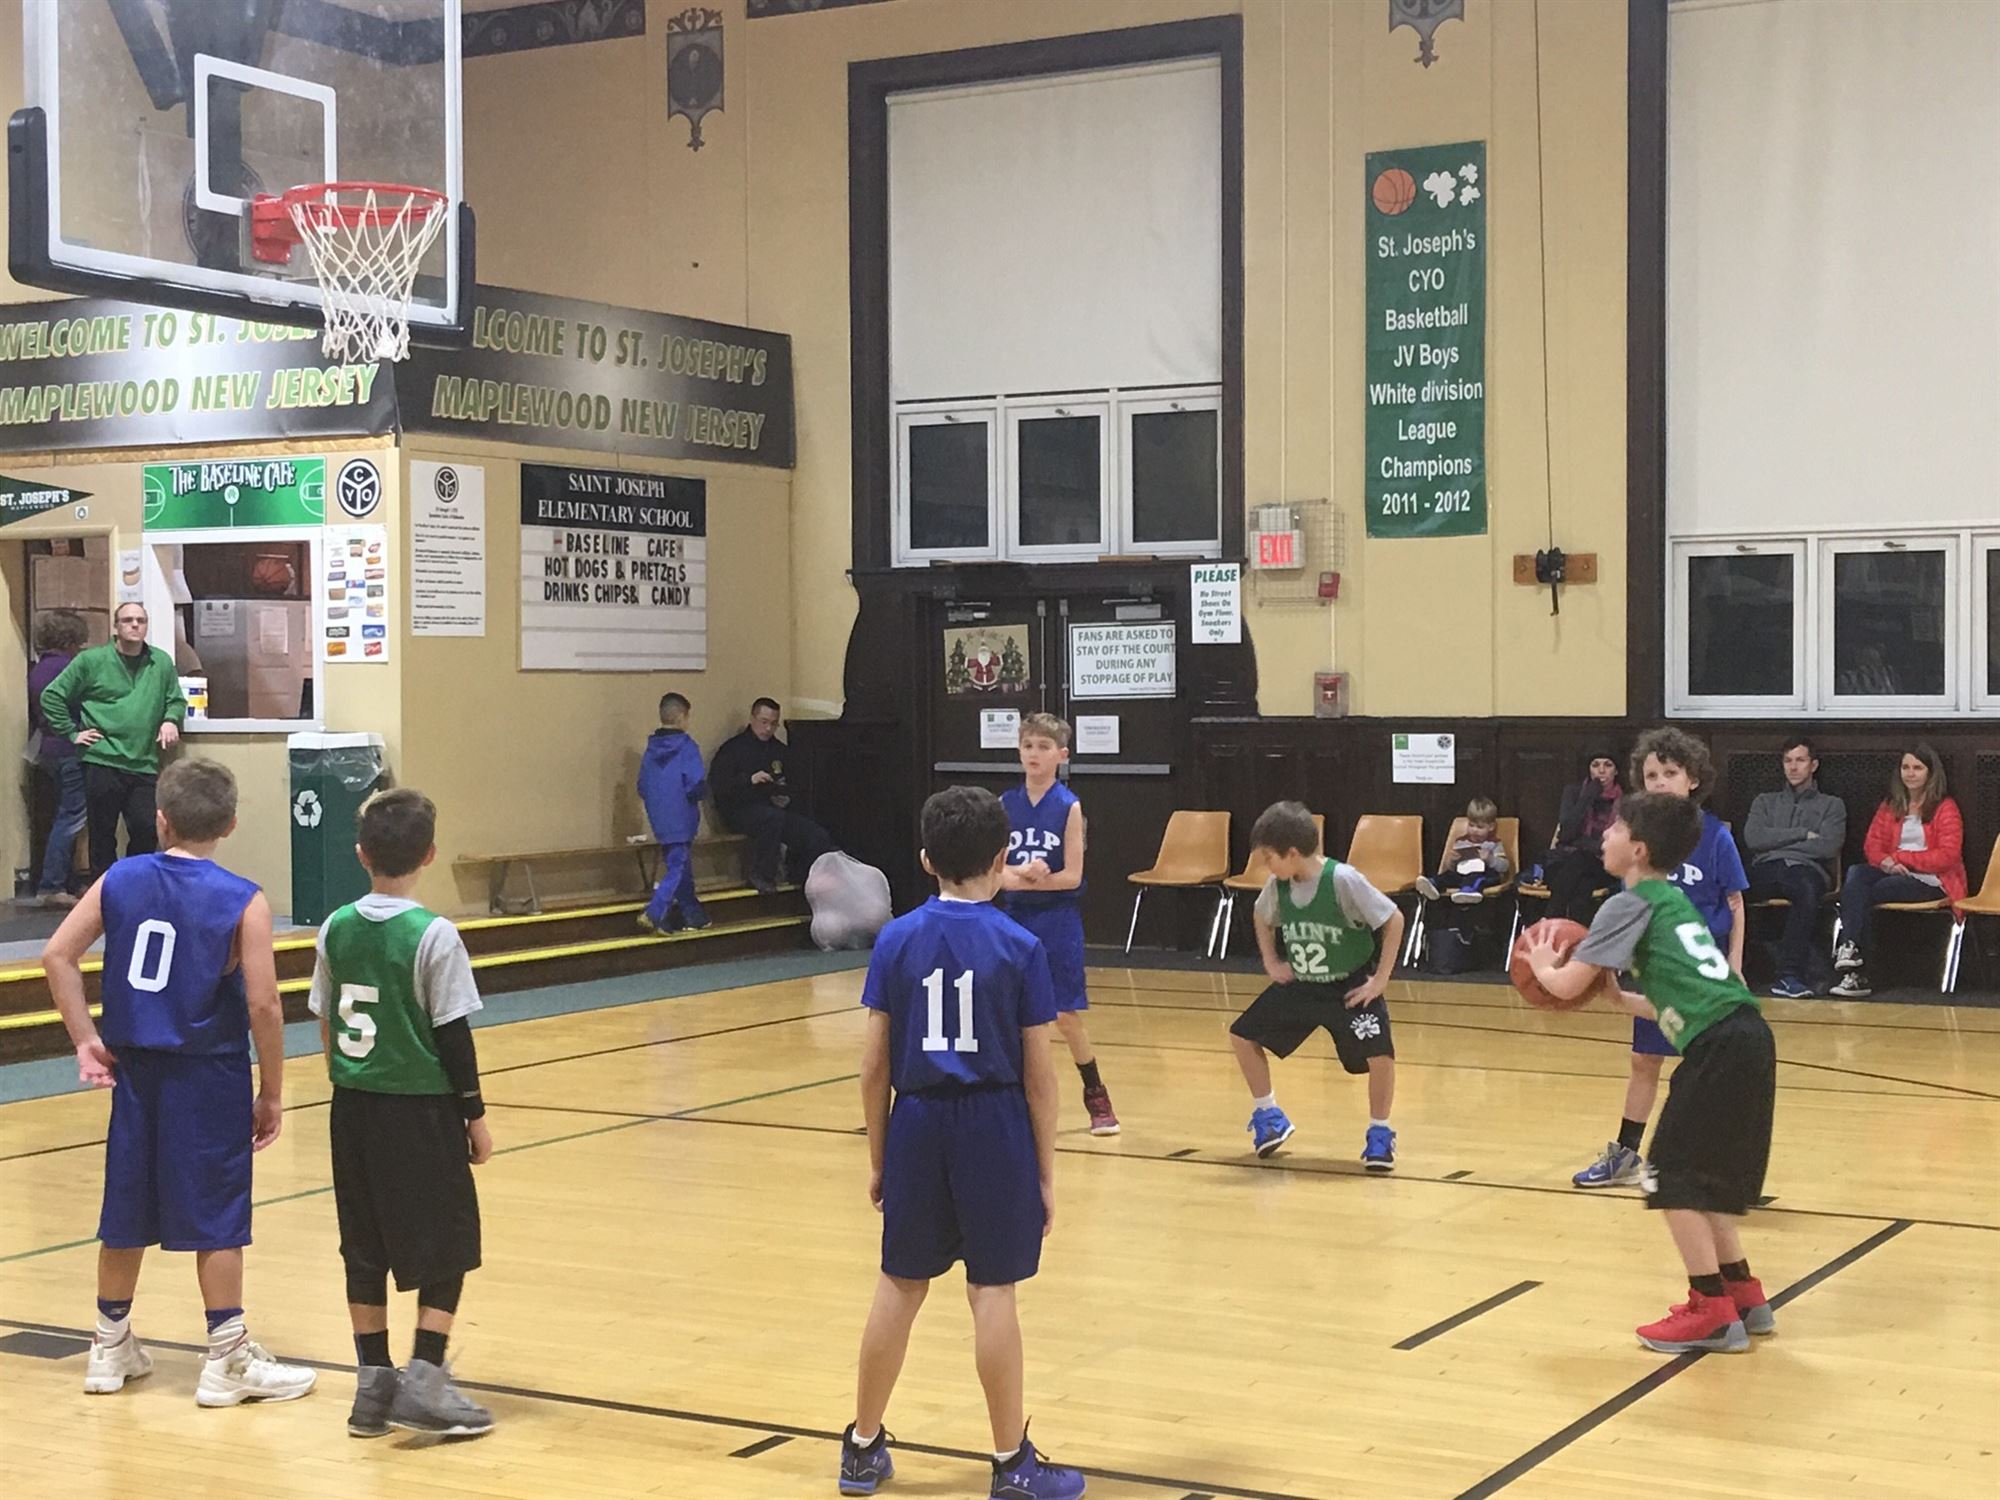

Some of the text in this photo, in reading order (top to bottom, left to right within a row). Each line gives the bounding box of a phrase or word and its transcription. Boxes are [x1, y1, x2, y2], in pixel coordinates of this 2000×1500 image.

[1378, 228, 1476, 258] St. Joseph's
[1408, 268, 1445, 292] CYO
[1385, 303, 1468, 331] Basketball
[0, 314, 132, 361] WELCOME
[143, 311, 178, 349] TO
[473, 305, 767, 386] LCOME TO ST. JOSEPH'S
[1393, 343, 1460, 370] JV Boys
[0, 363, 380, 425] MAPLEWOOD NEW JERSEY
[1369, 378, 1483, 406] White division
[431, 374, 766, 450] MAPLEWOOD NEW JERSEY
[1398, 419, 1457, 445] League
[168, 466, 197, 496] THE
[200, 463, 263, 491] BASELINE
[1380, 454, 1473, 482] Champions
[0, 489, 70, 507] ST. JOSEPH'S
[568, 472, 665, 498] SAINT JOSEPH
[537, 499, 694, 529] ELEMENTARY SCHOOL
[1382, 492, 1418, 515] 2011
[1434, 490, 1471, 513] 2012
[566, 533, 630, 556] BASELINE
[647, 537, 676, 559] CAFE
[1259, 535, 1293, 565] EXIT
[544, 556, 687, 586] HOT DOGS & PRETZELS
[1194, 569, 1238, 584] PLEASE
[543, 581, 590, 602] DRINKS
[651, 586, 691, 606] CANDY
[1200, 599, 1220, 607] Shoes
[1211, 589, 1232, 598] Street
[1078, 628, 1174, 641] FANS ARE ASKED TO
[1200, 619, 1232, 627] Sneakers
[1208, 629, 1225, 637] Only
[1076, 643, 1176, 656] STAY OFF THE COURT
[1095, 657, 1157, 670] DURING ANY
[1080, 672, 1173, 685] STOPPAGE OF PLAY
[1008, 827, 1061, 850] OLP
[1282, 921, 1343, 945] SAINT
[127, 918, 177, 993] 0
[1290, 942, 1329, 974] 32
[1674, 921, 1730, 981] 5
[337, 983, 379, 1058] 5
[922, 968, 979, 1053] 11
